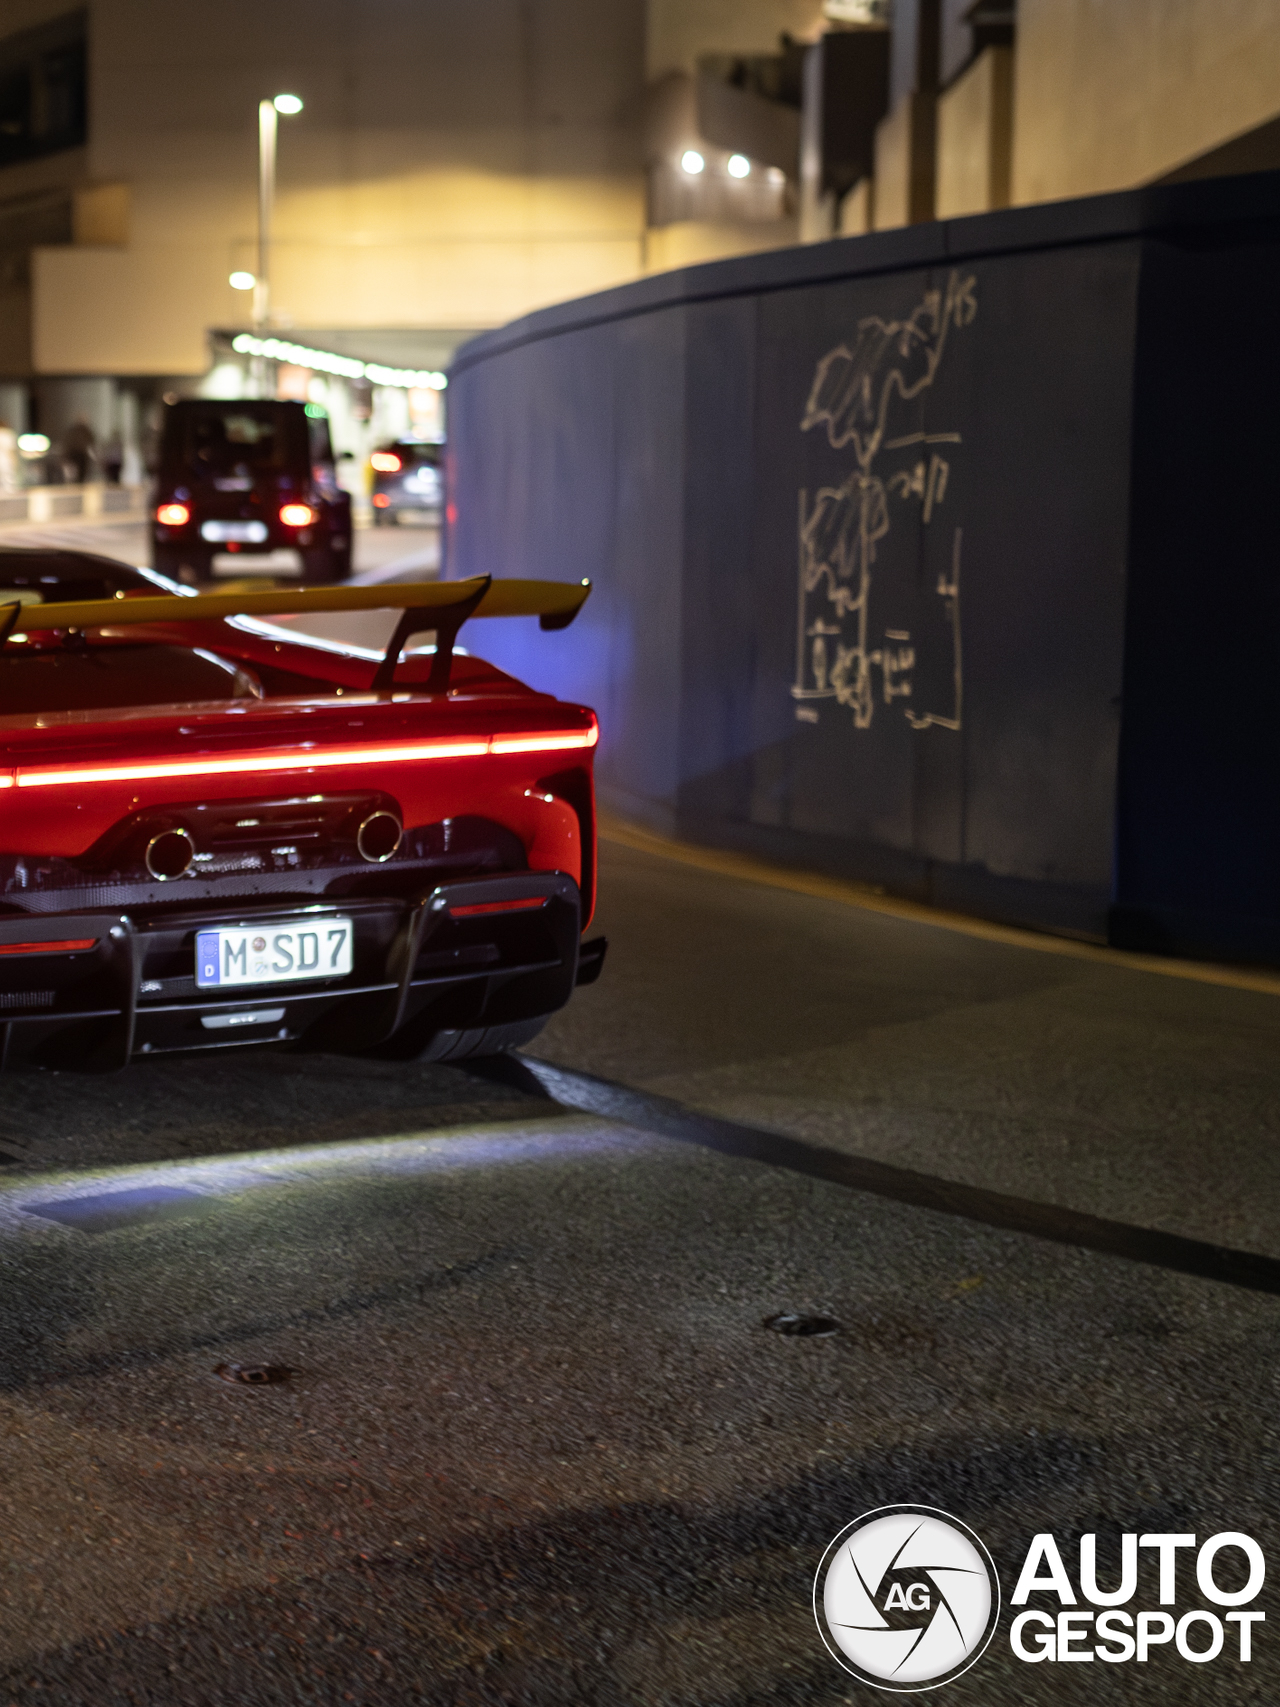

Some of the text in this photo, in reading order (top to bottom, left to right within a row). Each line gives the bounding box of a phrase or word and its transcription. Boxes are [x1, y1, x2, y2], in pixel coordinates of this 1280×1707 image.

[223, 938, 247, 977] M
[327, 929, 347, 968] 7
[204, 964, 215, 977] D
